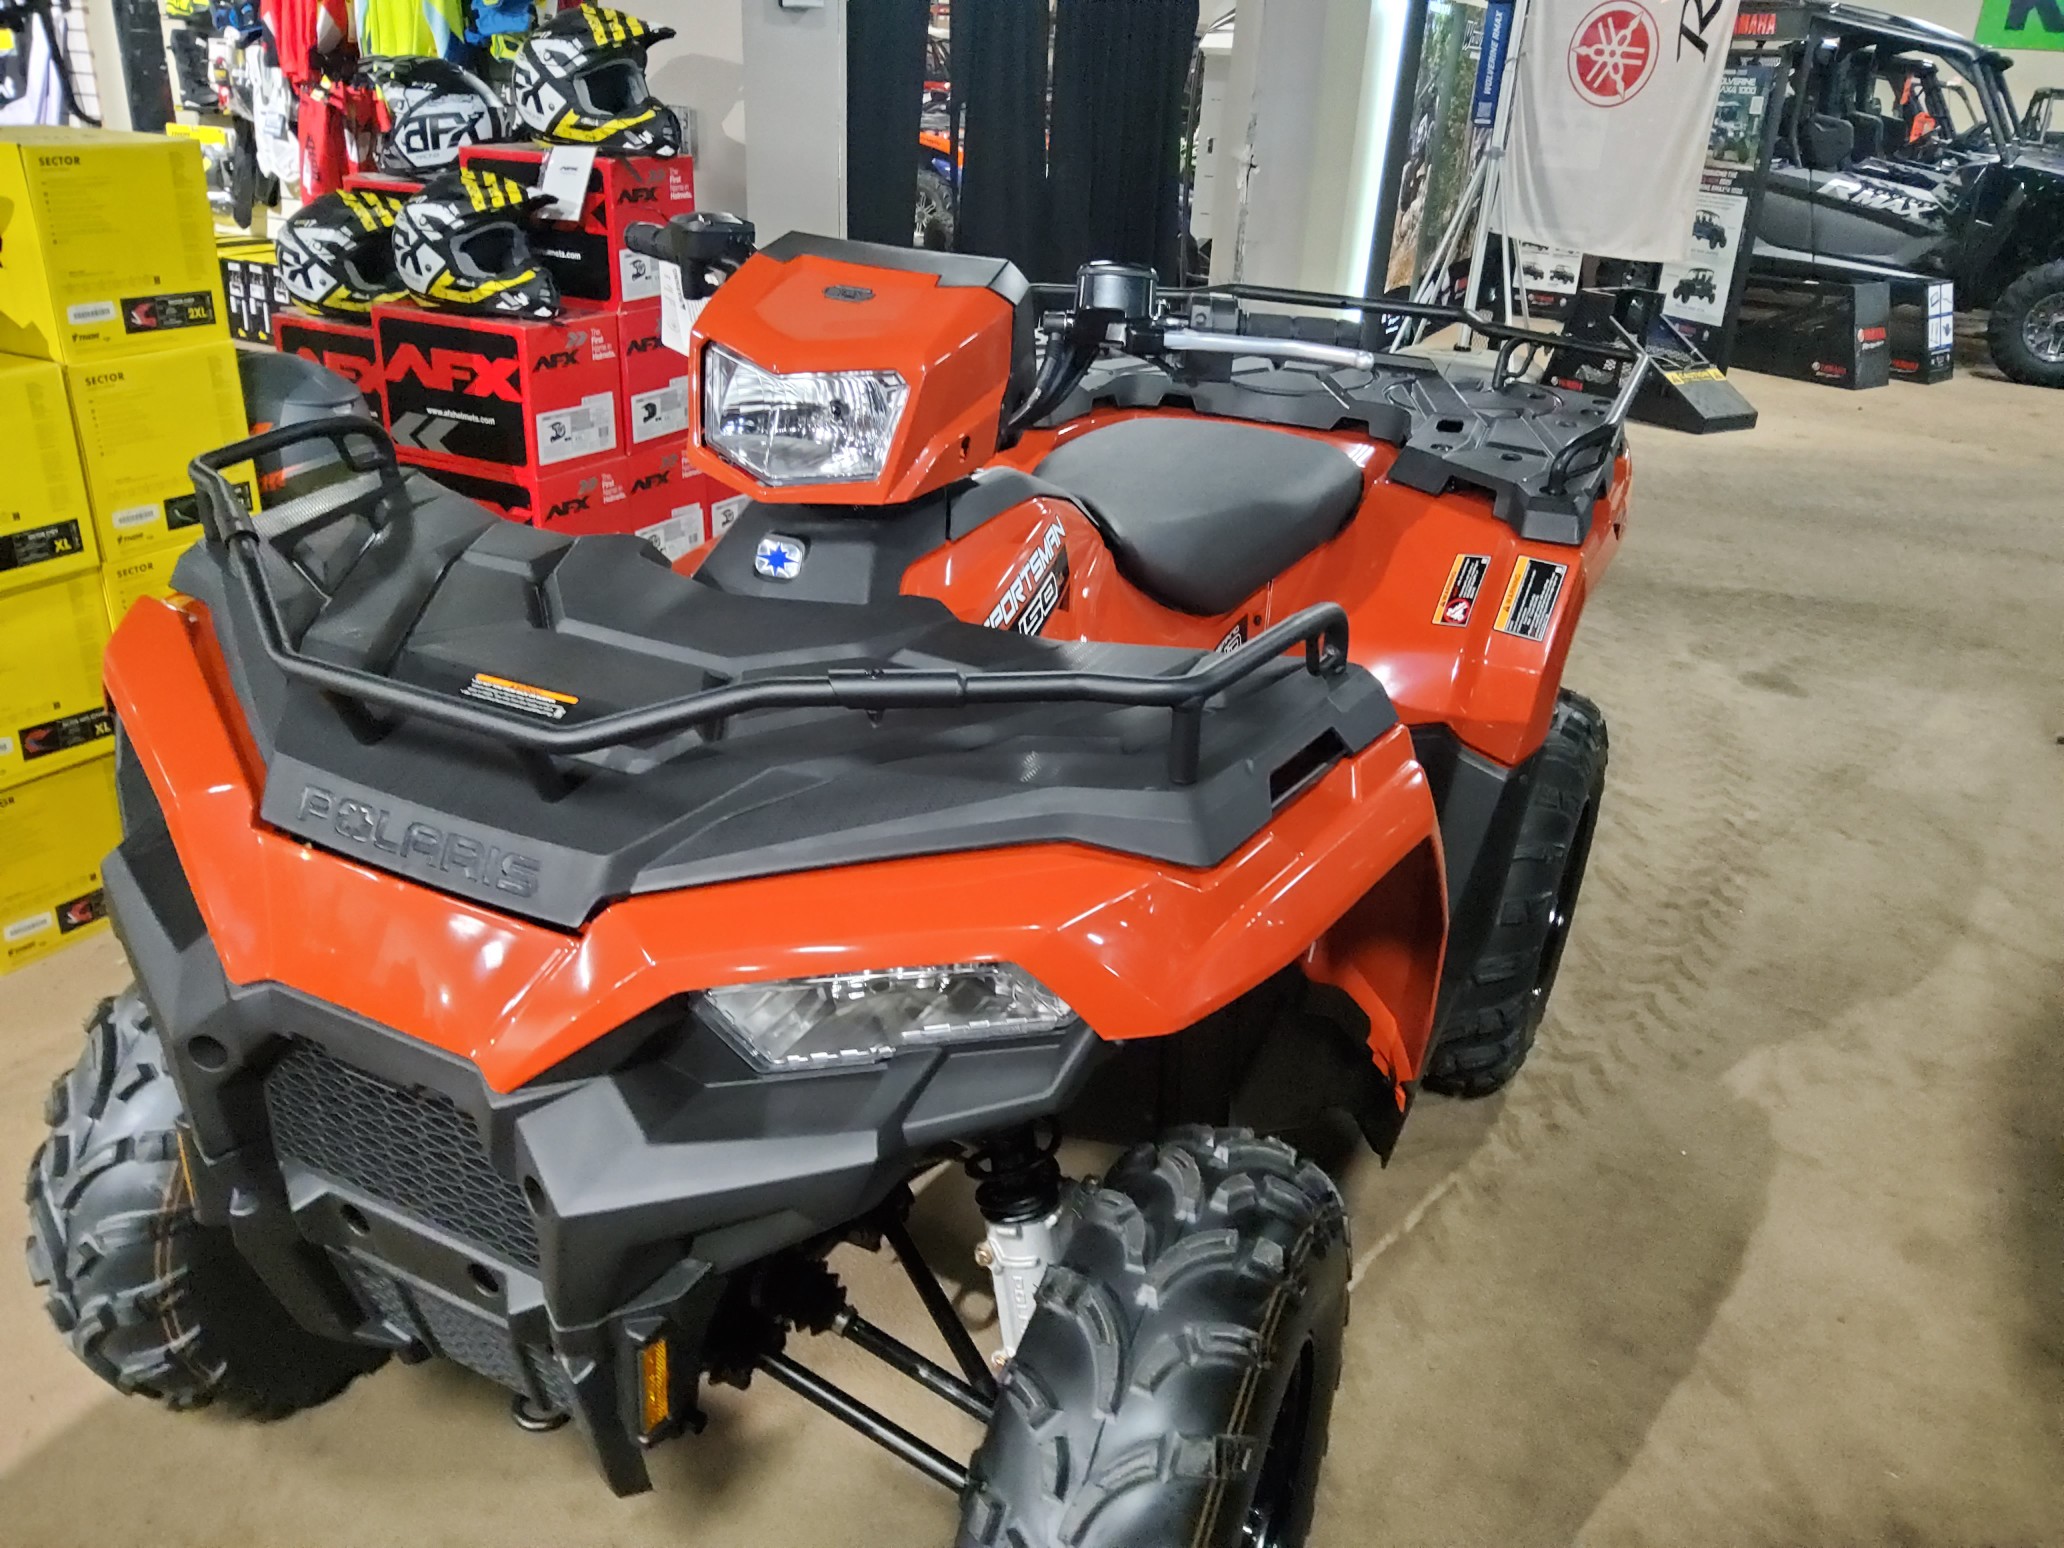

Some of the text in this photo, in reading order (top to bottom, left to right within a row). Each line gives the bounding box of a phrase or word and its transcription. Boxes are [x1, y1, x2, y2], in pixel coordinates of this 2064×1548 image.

[1484, 40, 1499, 95] WOLVERINE
[38, 156, 81, 168] SECTOR
[617, 186, 662, 205] AFX
[188, 306, 207, 319] 2XL
[385, 342, 523, 403] AFX
[533, 350, 580, 373] AFX
[85, 372, 125, 387] SECTOR
[630, 470, 669, 495] AFX
[545, 496, 590, 522] AFX
[54, 537, 72, 553] XL
[116, 562, 154, 579] SECTOR
[984, 515, 1066, 630] PORTSMAN
[1018, 571, 1058, 636] 50
[95, 721, 112, 736] XL
[296, 784, 543, 899] POLARIS
